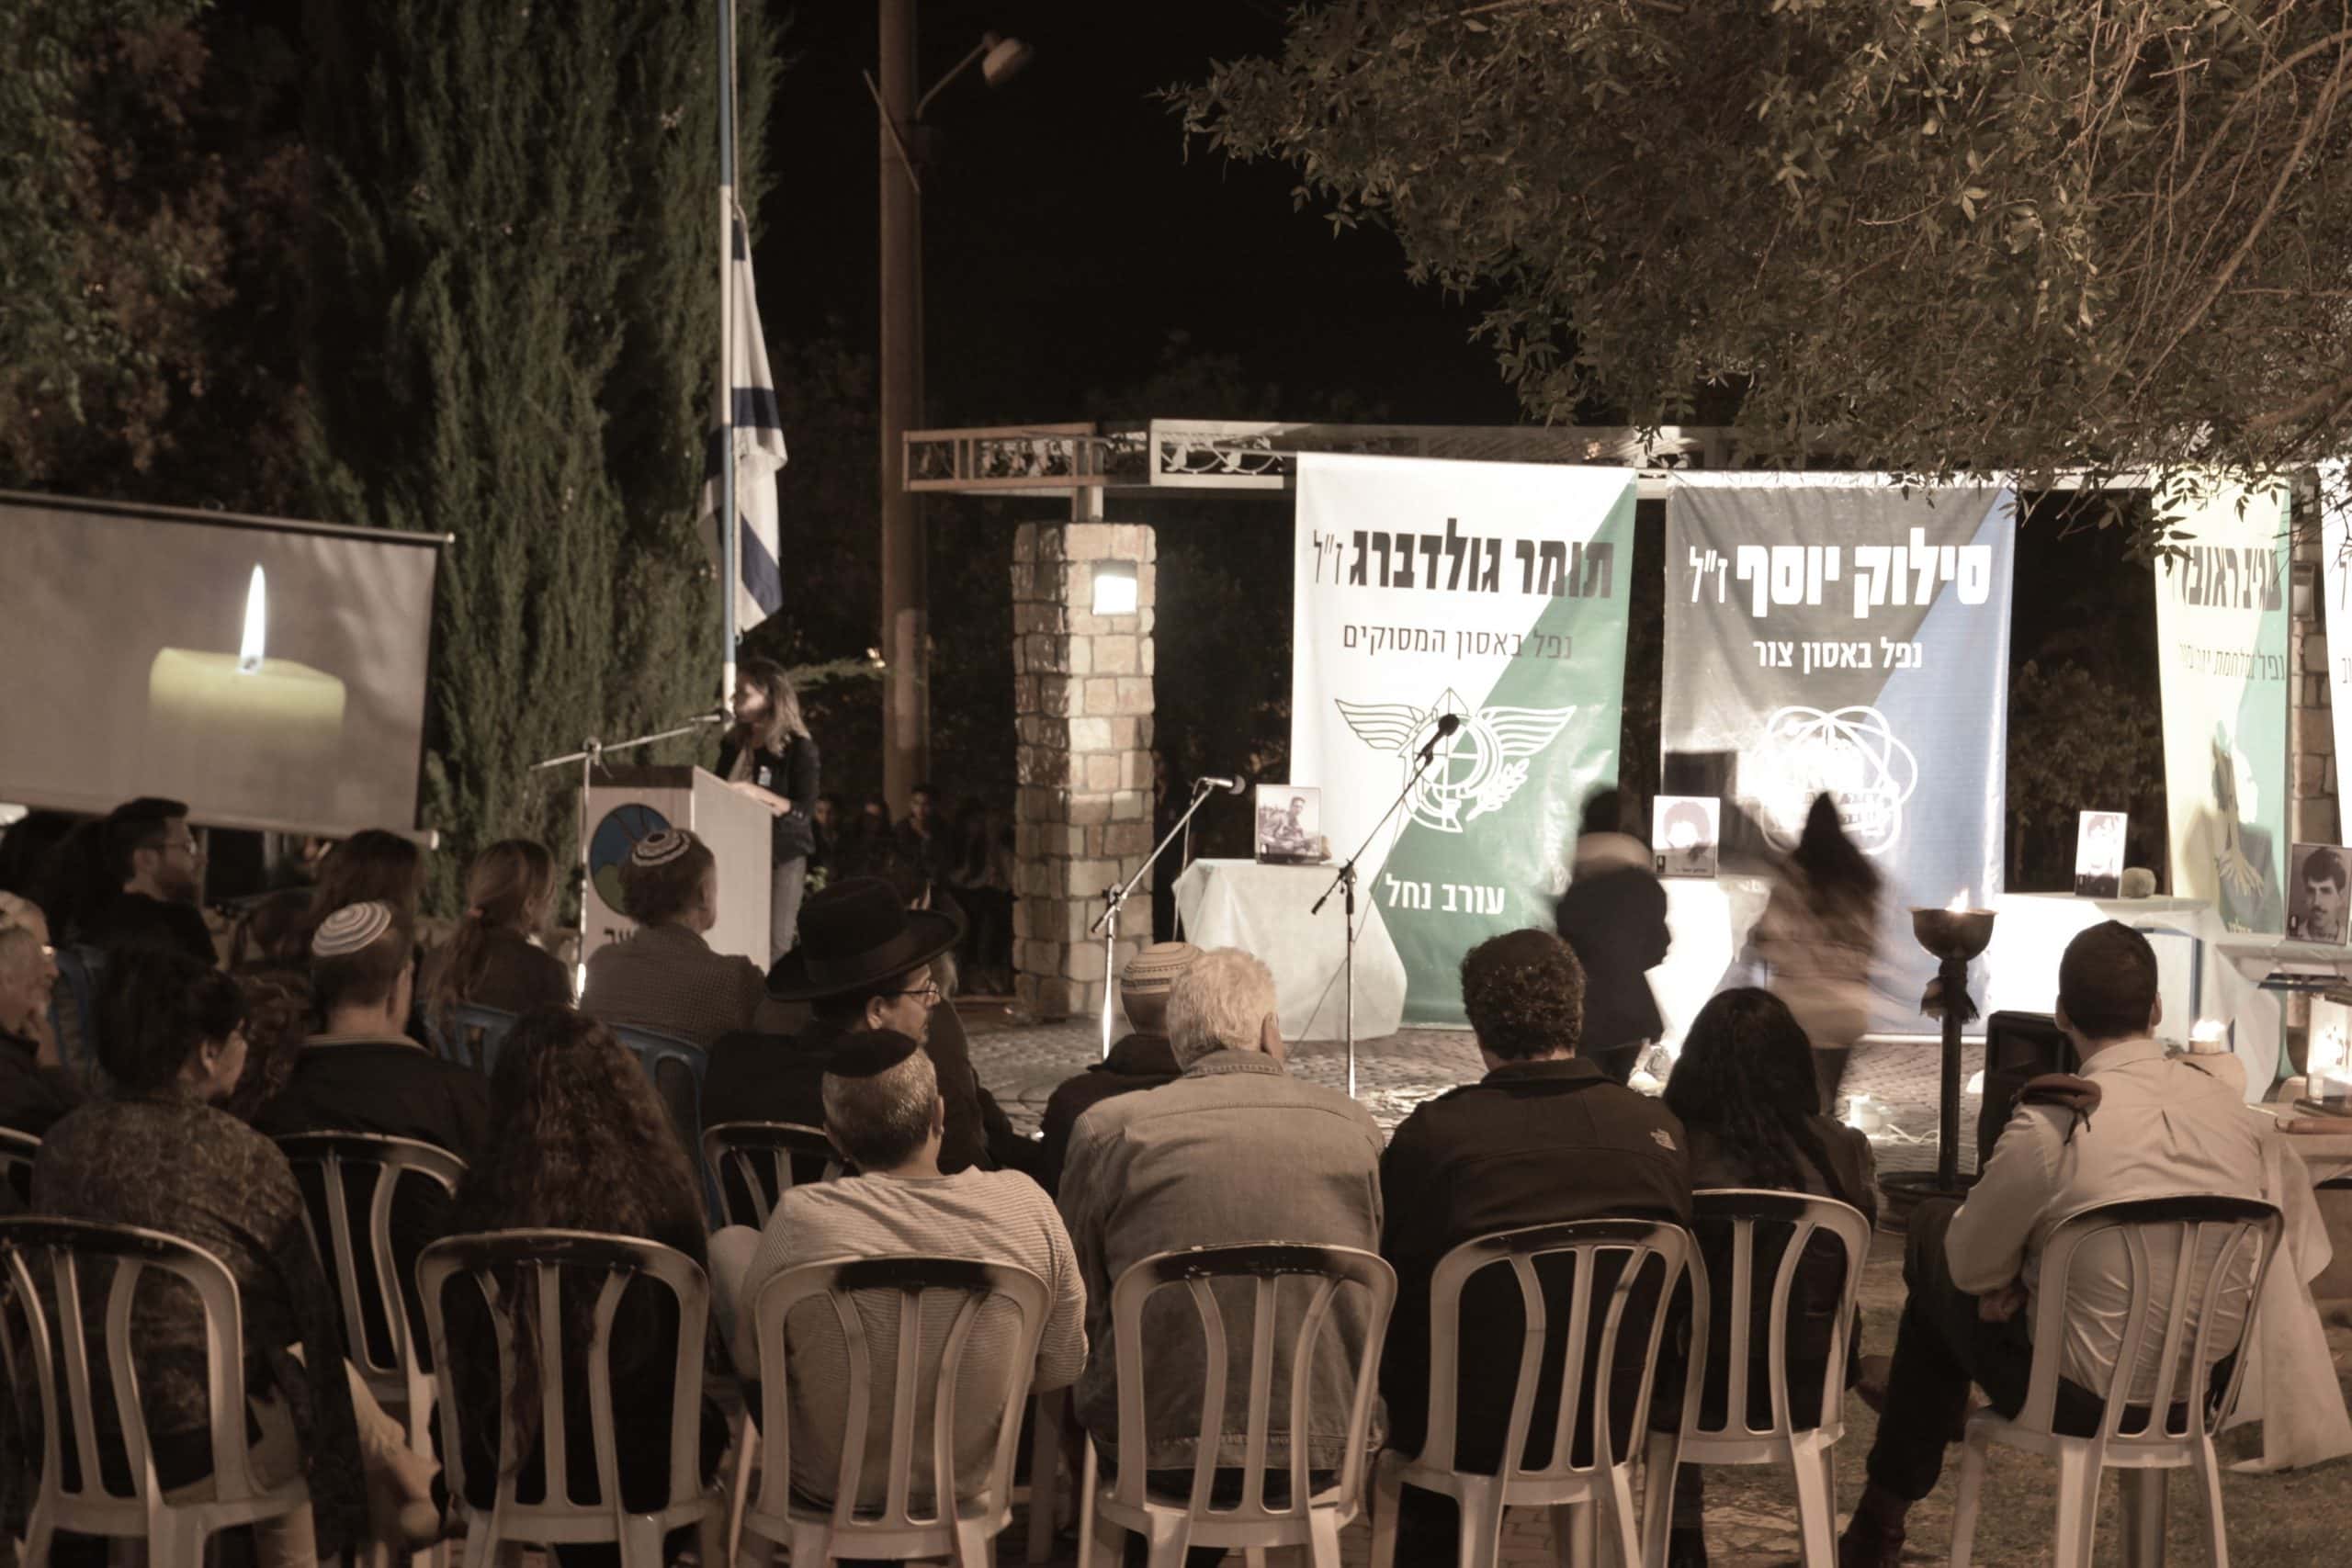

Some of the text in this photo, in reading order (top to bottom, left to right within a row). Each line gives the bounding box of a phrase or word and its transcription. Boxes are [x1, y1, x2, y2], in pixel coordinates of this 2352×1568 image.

[1349, 517, 1502, 594] גולדברג
[1515, 539, 1614, 599] תומר
[1689, 526, 1992, 619] סילוק יוסף ז"ל
[1343, 624, 1573, 660] נפל באסון המסוקים
[1753, 636, 1923, 674] נפל באסון צור
[2257, 647, 2285, 681] נפל
[1385, 873, 1505, 915] עורב נחל
